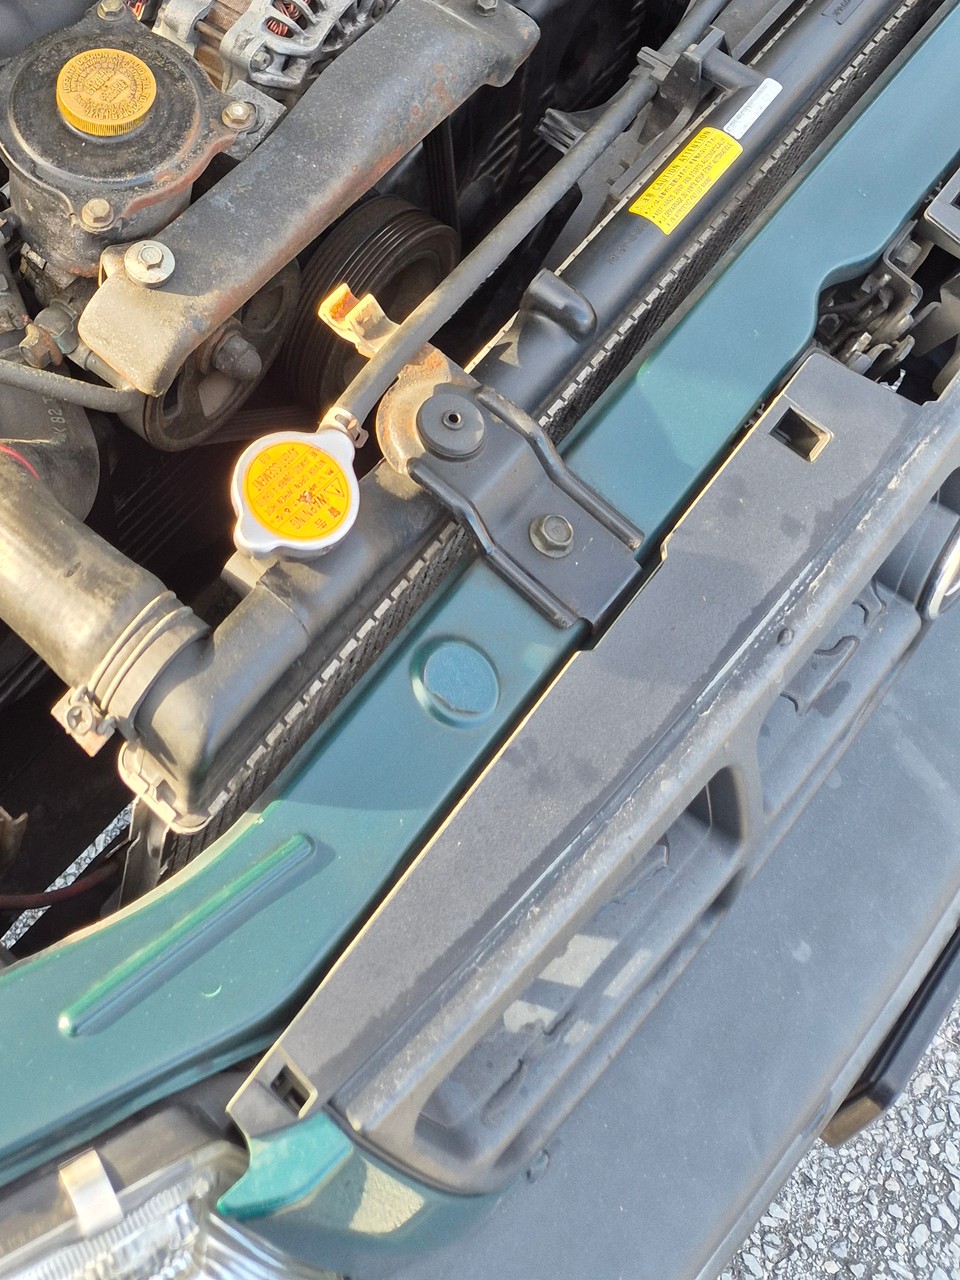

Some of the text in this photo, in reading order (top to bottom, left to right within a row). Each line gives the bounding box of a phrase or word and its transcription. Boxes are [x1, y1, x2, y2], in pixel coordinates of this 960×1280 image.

[652, 162, 680, 192] CAUTION
[678, 128, 711, 164] ATTENTION
[289, 493, 328, 530] WARNING
